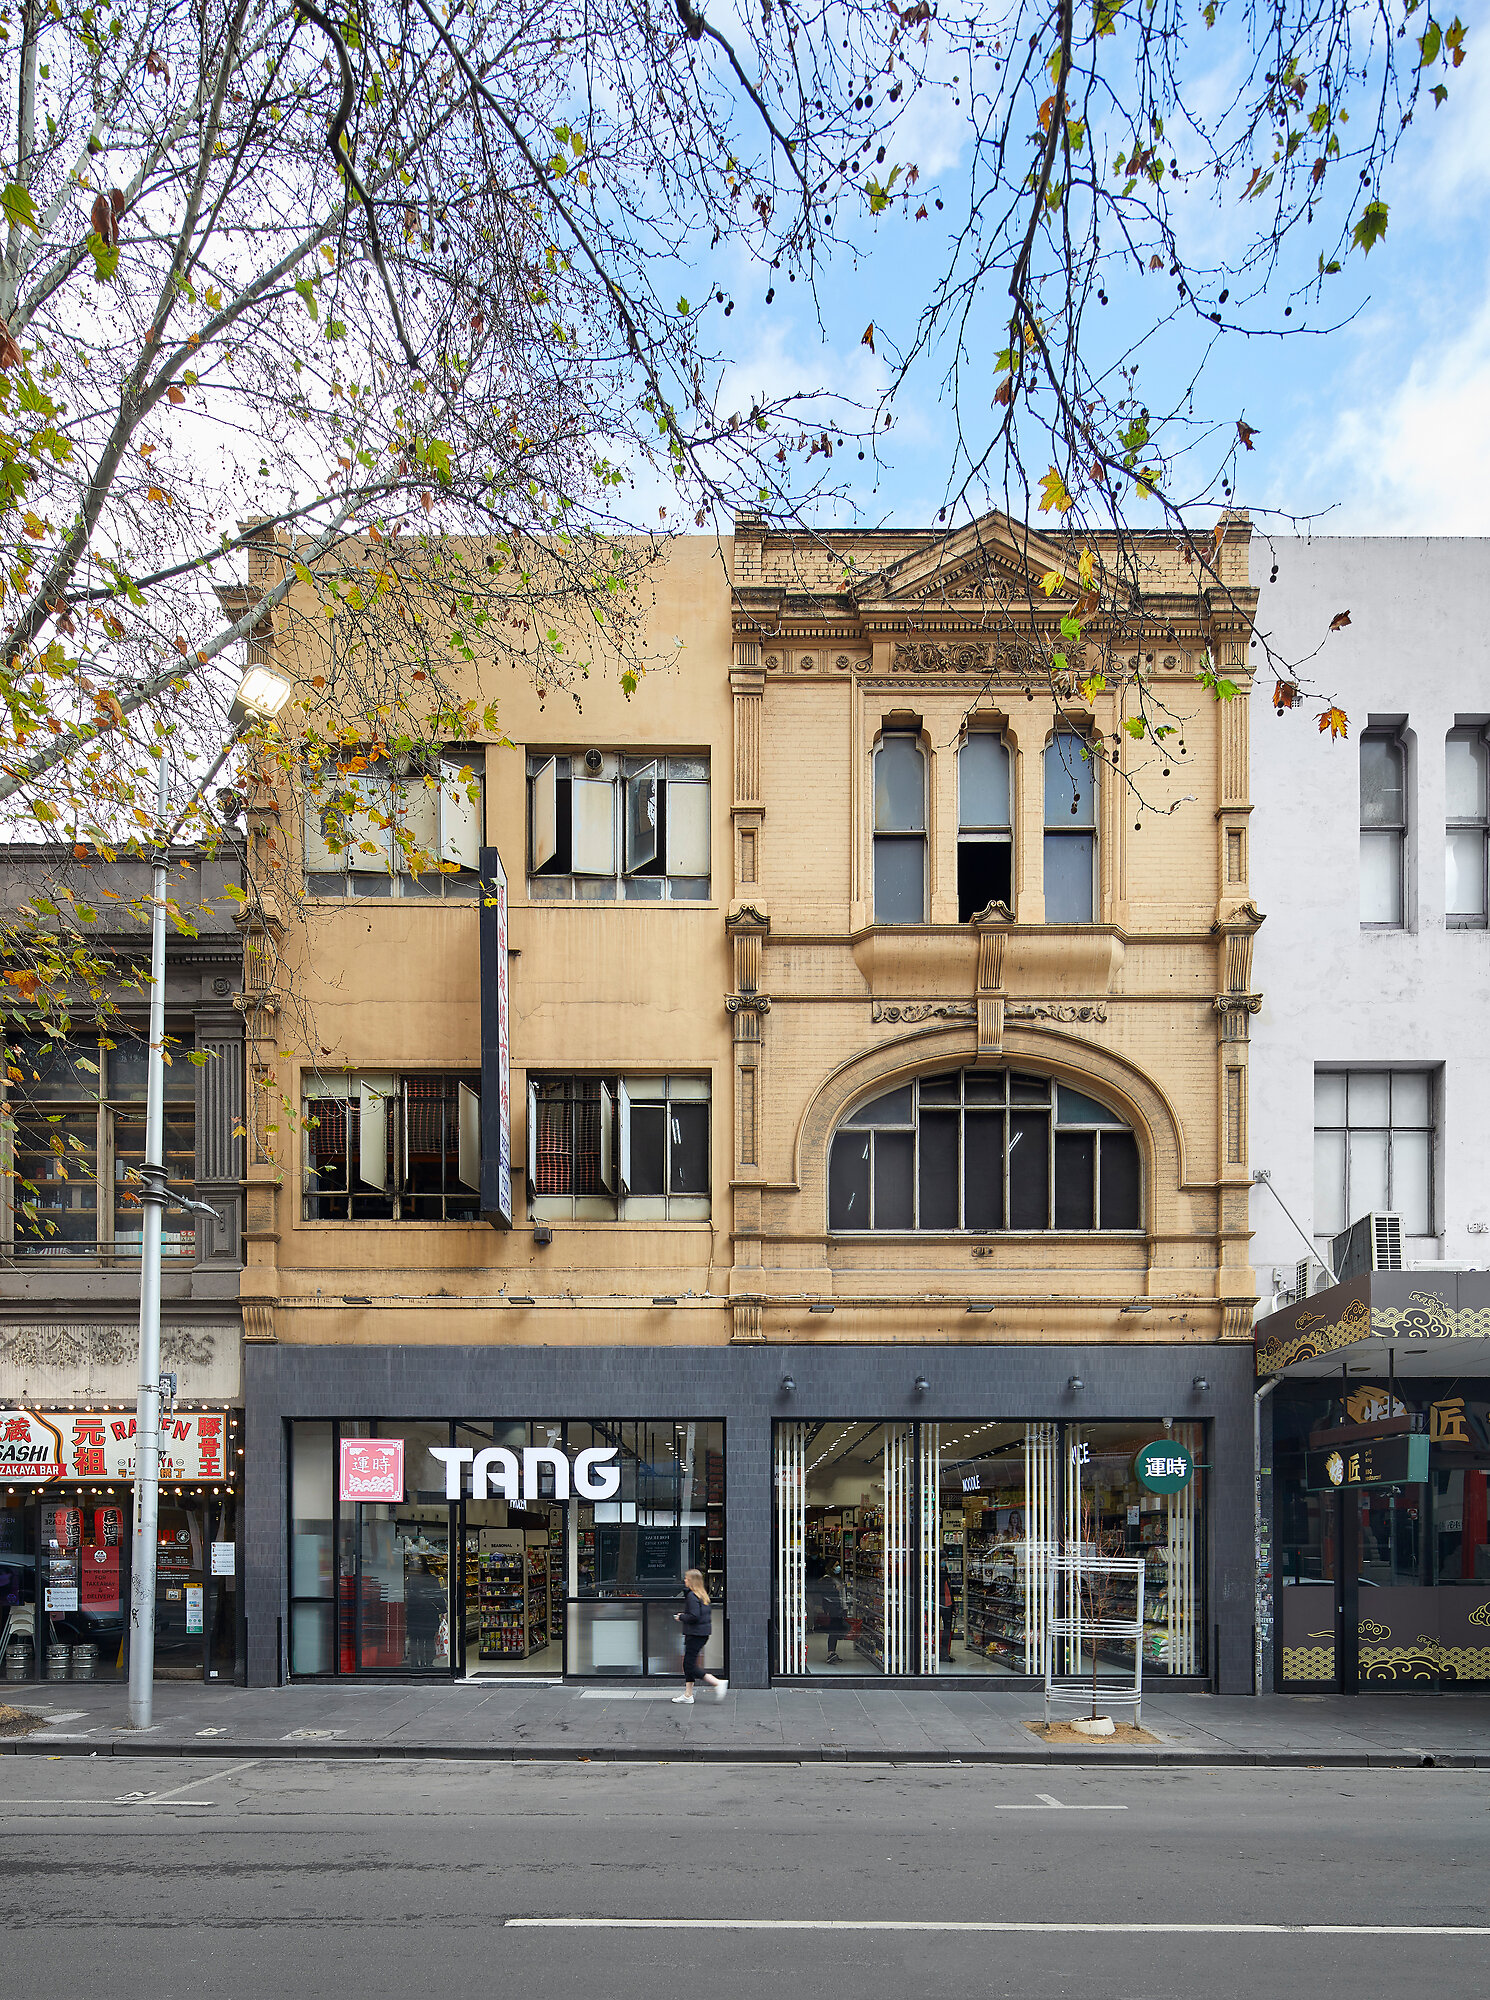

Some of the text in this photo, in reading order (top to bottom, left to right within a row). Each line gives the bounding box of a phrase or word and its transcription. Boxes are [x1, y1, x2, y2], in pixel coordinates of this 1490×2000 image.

[71, 1418, 107, 1476] 元祖
[197, 1417, 222, 1476] 豚骨王
[352, 1455, 391, 1474] 運時
[40, 1466, 59, 1475] BAR
[428, 1447, 620, 1500] TANG
[1145, 1457, 1187, 1477] 運時
